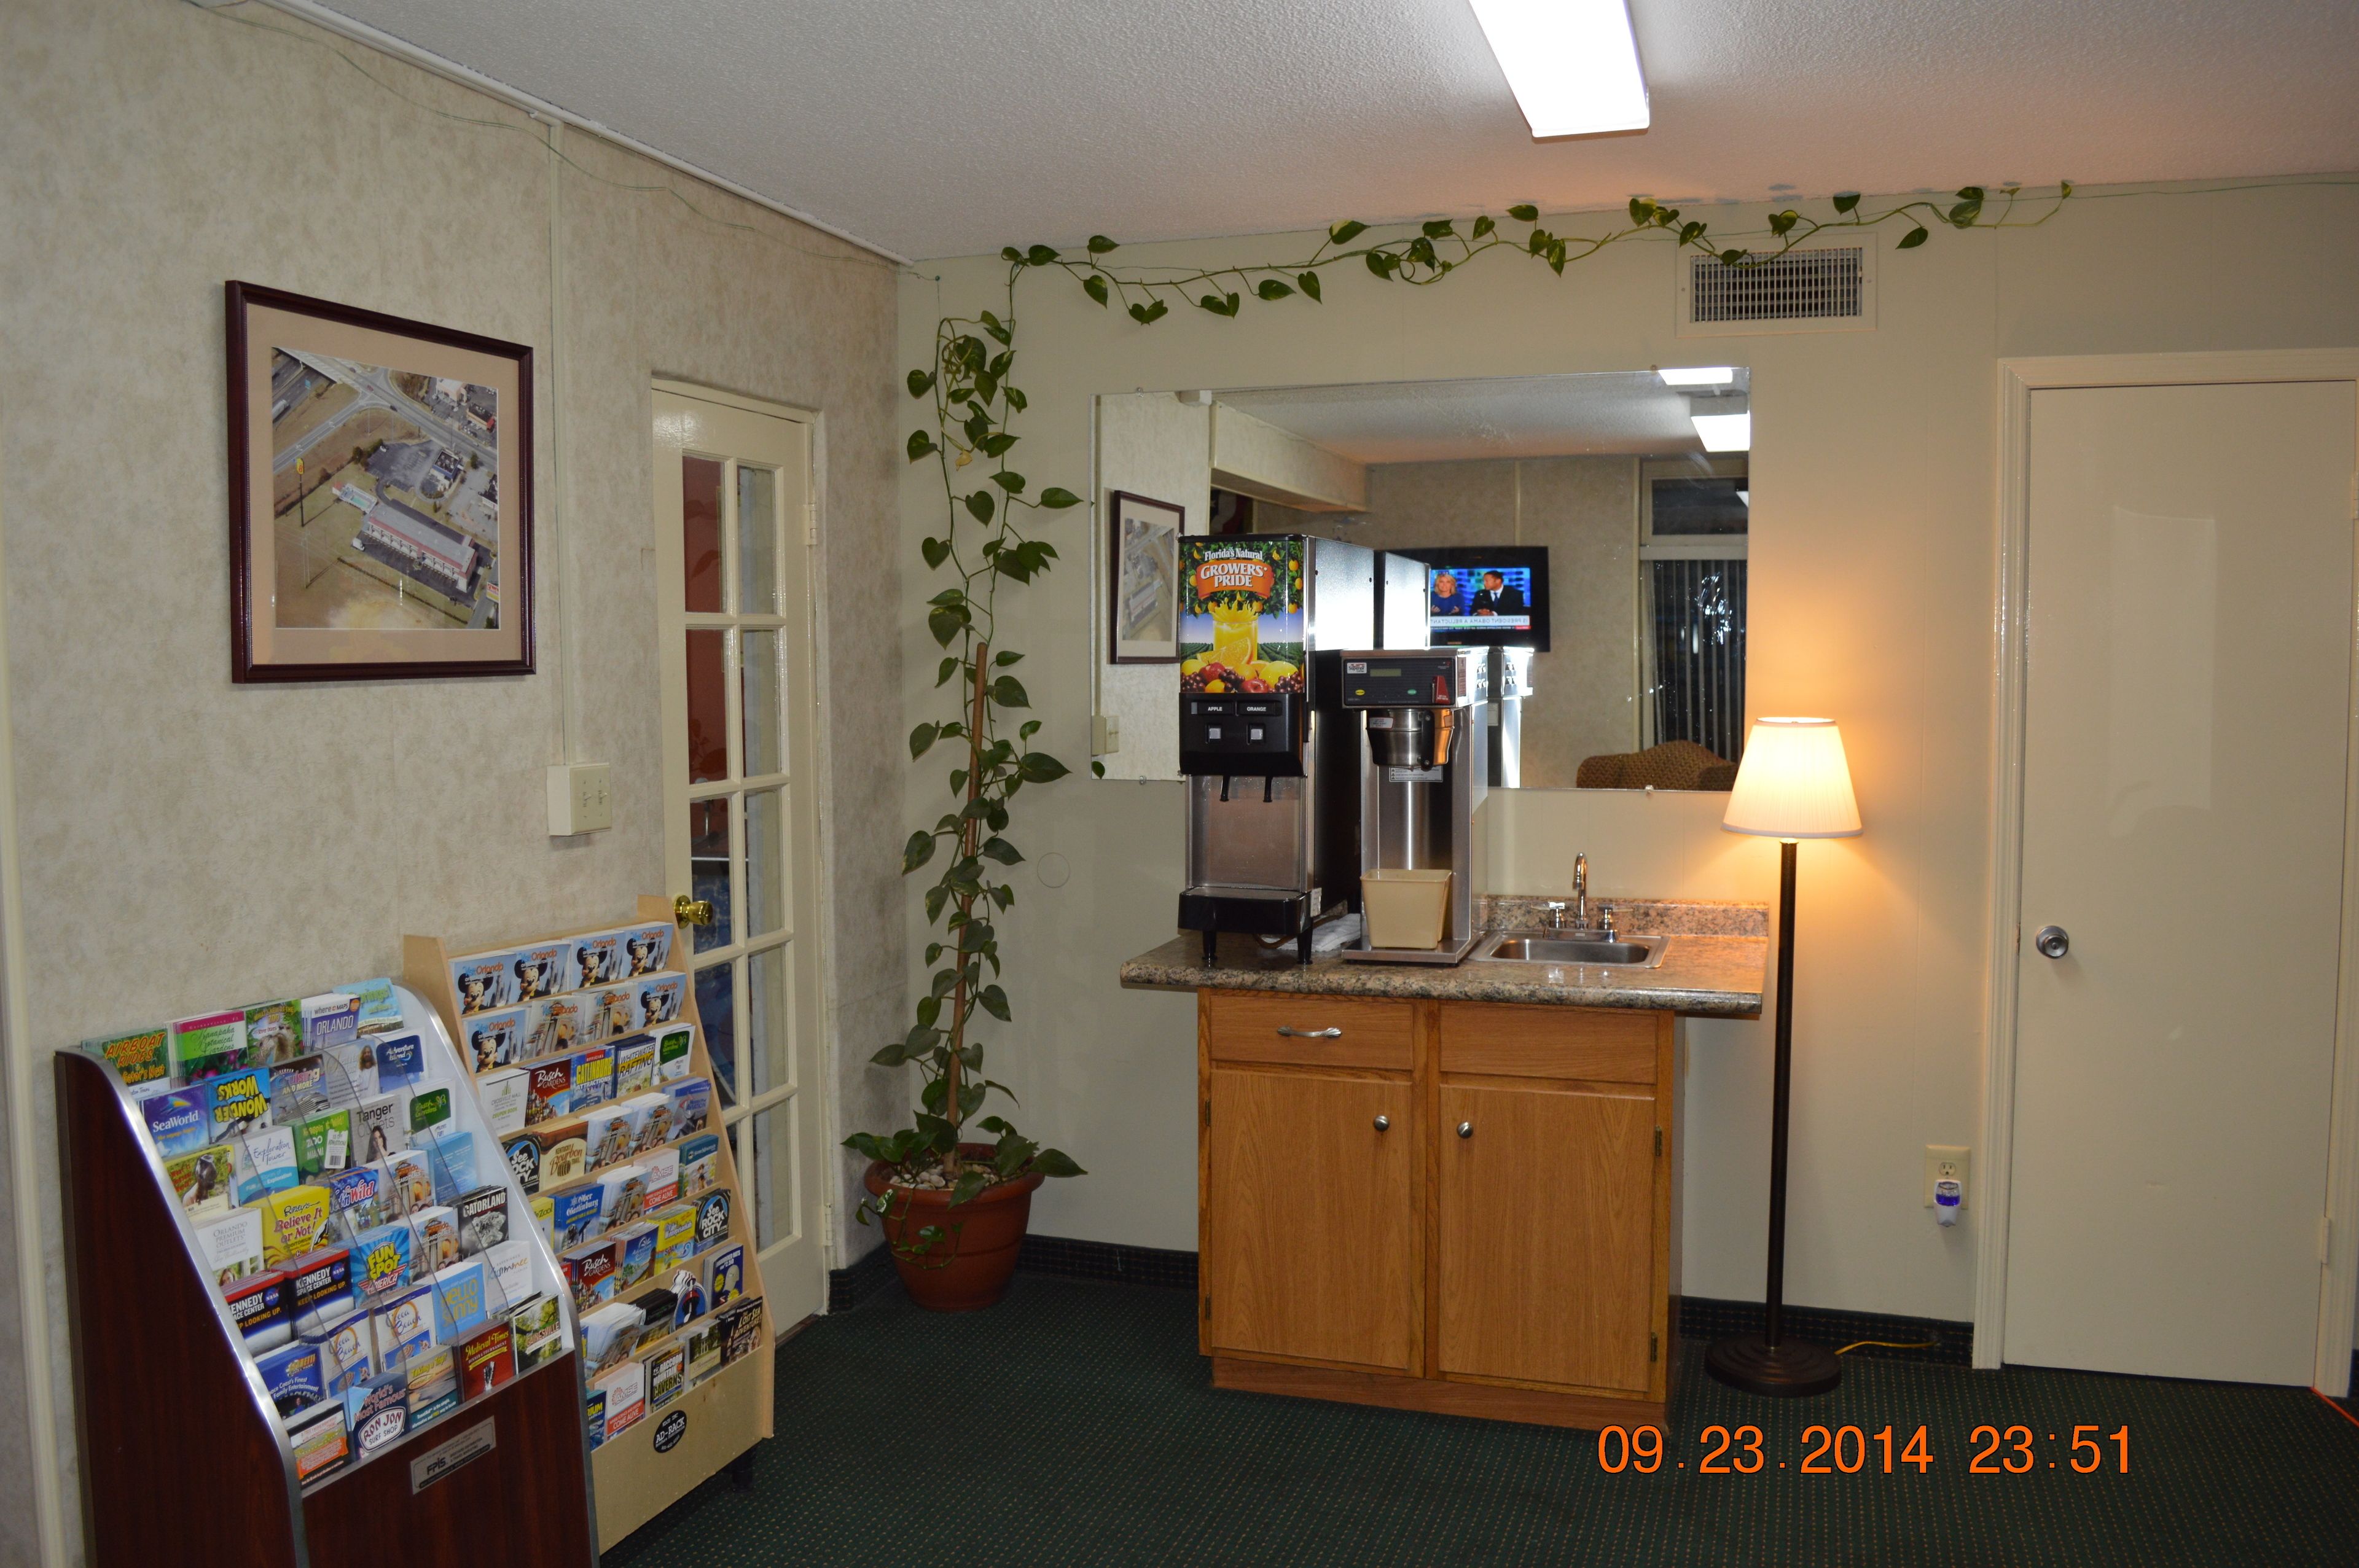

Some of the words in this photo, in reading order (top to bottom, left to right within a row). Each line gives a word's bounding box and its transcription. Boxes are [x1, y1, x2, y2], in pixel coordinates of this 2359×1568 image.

[1204, 548, 1235, 561] Florida's
[1236, 547, 1263, 560] Natural
[1215, 574, 1253, 587] PRIDE
[592, 937, 616, 949] Orlando
[641, 929, 664, 940] Orlando
[531, 948, 557, 961] Orlando
[476, 962, 504, 975] Orlando
[350, 985, 392, 1004] prings!
[655, 981, 678, 992] Orlando
[317, 1015, 354, 1036] ORLANDO
[488, 1018, 515, 1032] Orlando
[106, 1032, 166, 1059] AIRBOAT
[386, 1045, 414, 1055] Adventure
[620, 1044, 655, 1063] WHITEWATER
[117, 1049, 154, 1067] RIDES
[586, 1053, 604, 1063] OFFICIAL
[619, 1053, 654, 1078] RAFTING
[149, 1064, 165, 1079] Nest
[278, 1067, 321, 1089] Cruising
[535, 1067, 564, 1087] Busch
[576, 1058, 613, 1085] GATLINBURG
[217, 1075, 259, 1101] WORKS
[296, 1080, 313, 1091] MORE
[543, 1077, 566, 1090] GARDENS
[576, 1076, 611, 1091] ATTRACTIONS
[214, 1094, 268, 1123] WONDER
[357, 1102, 394, 1123] Tanger
[153, 1110, 199, 1133] SeaWorld
[358, 1116, 395, 1137] Outlets
[253, 1138, 291, 1162] Exploration
[306, 1136, 323, 1147] ZOO
[265, 1151, 286, 1164] Tower
[307, 1147, 324, 1160] MIAMI
[512, 1150, 528, 1165] See
[549, 1144, 583, 1177] Bourbon
[512, 1158, 535, 1175] OCK
[652, 1165, 674, 1180] AMSE
[350, 1179, 375, 1204] Wild
[649, 1195, 662, 1205] COME
[662, 1190, 673, 1201] ALIVE
[463, 1192, 506, 1217] GATORLAND
[707, 1204, 719, 1215] See
[275, 1212, 311, 1232] Believe
[314, 1207, 323, 1219] It
[702, 1210, 725, 1230] ROCK
[281, 1233, 294, 1243] or
[294, 1221, 316, 1239] Not!
[367, 1242, 395, 1270] FUN
[582, 1254, 609, 1274] Busch
[295, 1266, 331, 1289] KENNEDY
[369, 1254, 401, 1281] SPOT
[589, 1262, 611, 1276] GARDENS
[297, 1284, 313, 1297] SPACE
[313, 1276, 332, 1290] CENTER
[369, 1273, 398, 1292] AMERICA
[297, 1295, 313, 1307] KEEP
[313, 1284, 337, 1301] LOOKING
[232, 1311, 244, 1320] ACE
[244, 1303, 265, 1317] CENTER
[245, 1311, 271, 1327] LOOKING
[738, 1315, 751, 1328] LOST
[751, 1306, 761, 1318] SEA
[526, 1321, 559, 1347] GAINESVILLE
[734, 1316, 762, 1339] ADVENTURE!
[466, 1336, 491, 1360] Medieval
[491, 1330, 509, 1344] Times
[468, 1355, 480, 1363] DINNER
[483, 1341, 507, 1355] TOURNAMENT
[411, 1365, 429, 1378] Taking
[435, 1352, 448, 1365] Trip?
[660, 1352, 683, 1371] RACCOON
[274, 1387, 288, 1399] Family
[288, 1383, 319, 1393] Entertainment!
[280, 1378, 294, 1388] Coast's
[614, 1382, 639, 1403] AMSE
[653, 1374, 683, 1398] CAVERNS
[364, 1384, 393, 1406] World's
[354, 1407, 374, 1423] Most
[374, 1389, 406, 1411] Famous
[364, 1418, 381, 1442] RON
[383, 1412, 402, 1427] JON
[613, 1417, 627, 1430] COME
[626, 1409, 640, 1422] ALIVE
[655, 1416, 685, 1443] AD-RACK
[369, 1433, 381, 1445] SURF
[383, 1424, 398, 1437] SHOP
